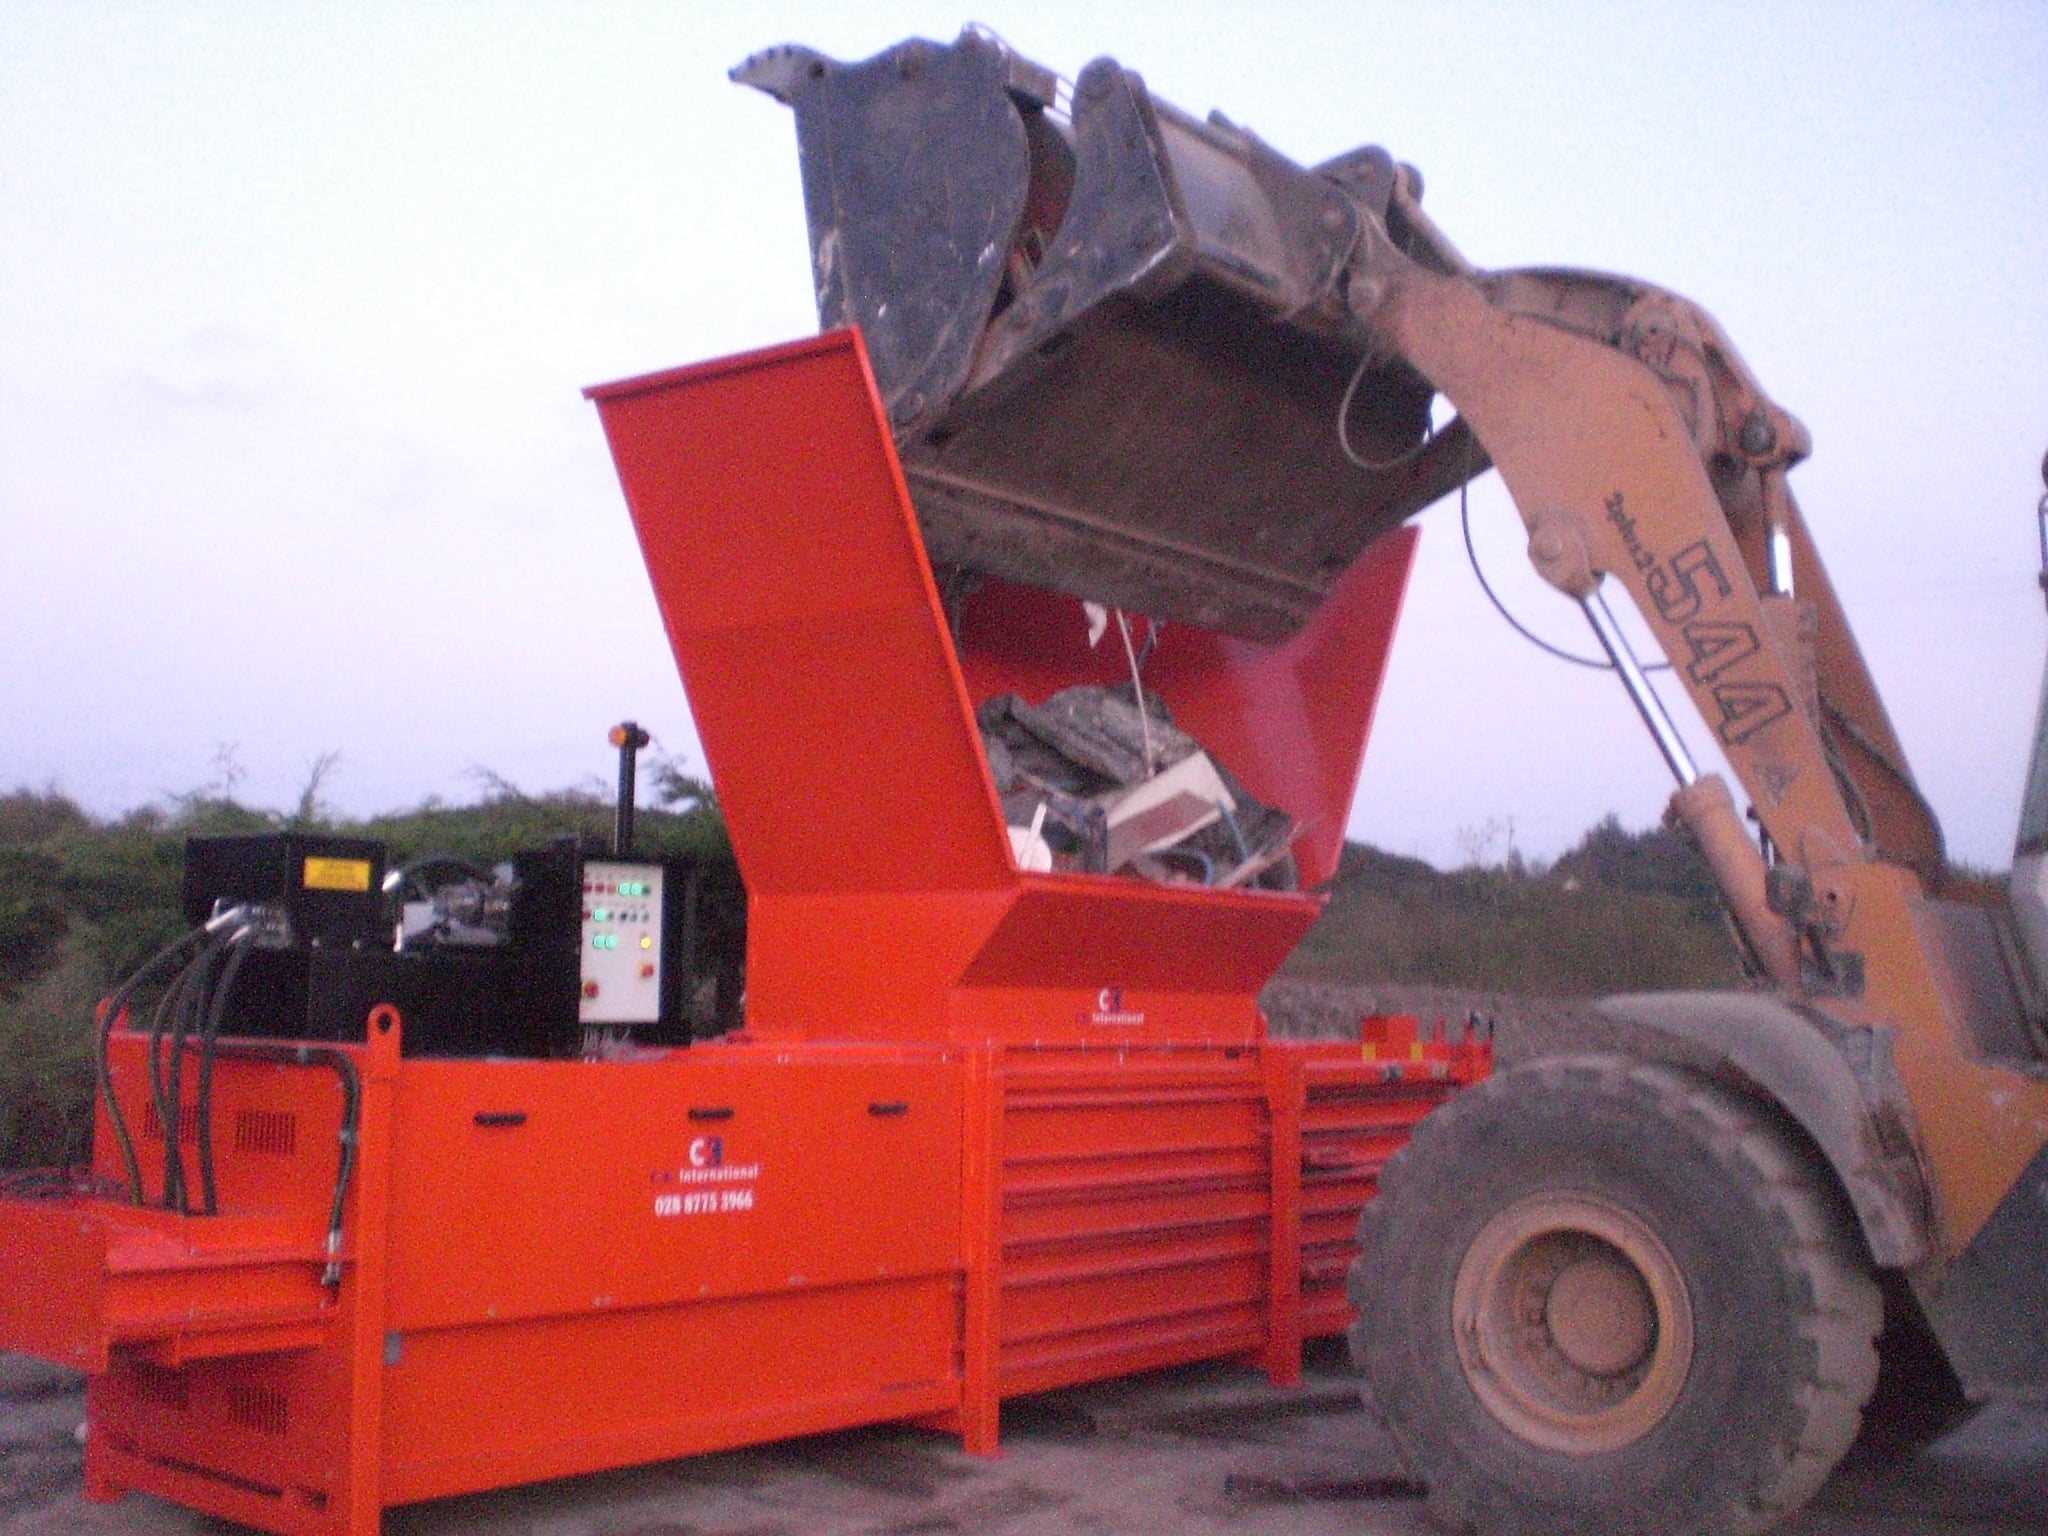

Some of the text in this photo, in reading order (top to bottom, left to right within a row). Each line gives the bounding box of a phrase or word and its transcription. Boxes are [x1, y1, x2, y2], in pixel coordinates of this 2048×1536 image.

[1647, 539, 1793, 747] 544
[679, 1163, 758, 1183] International
[655, 1193, 681, 1217] 028
